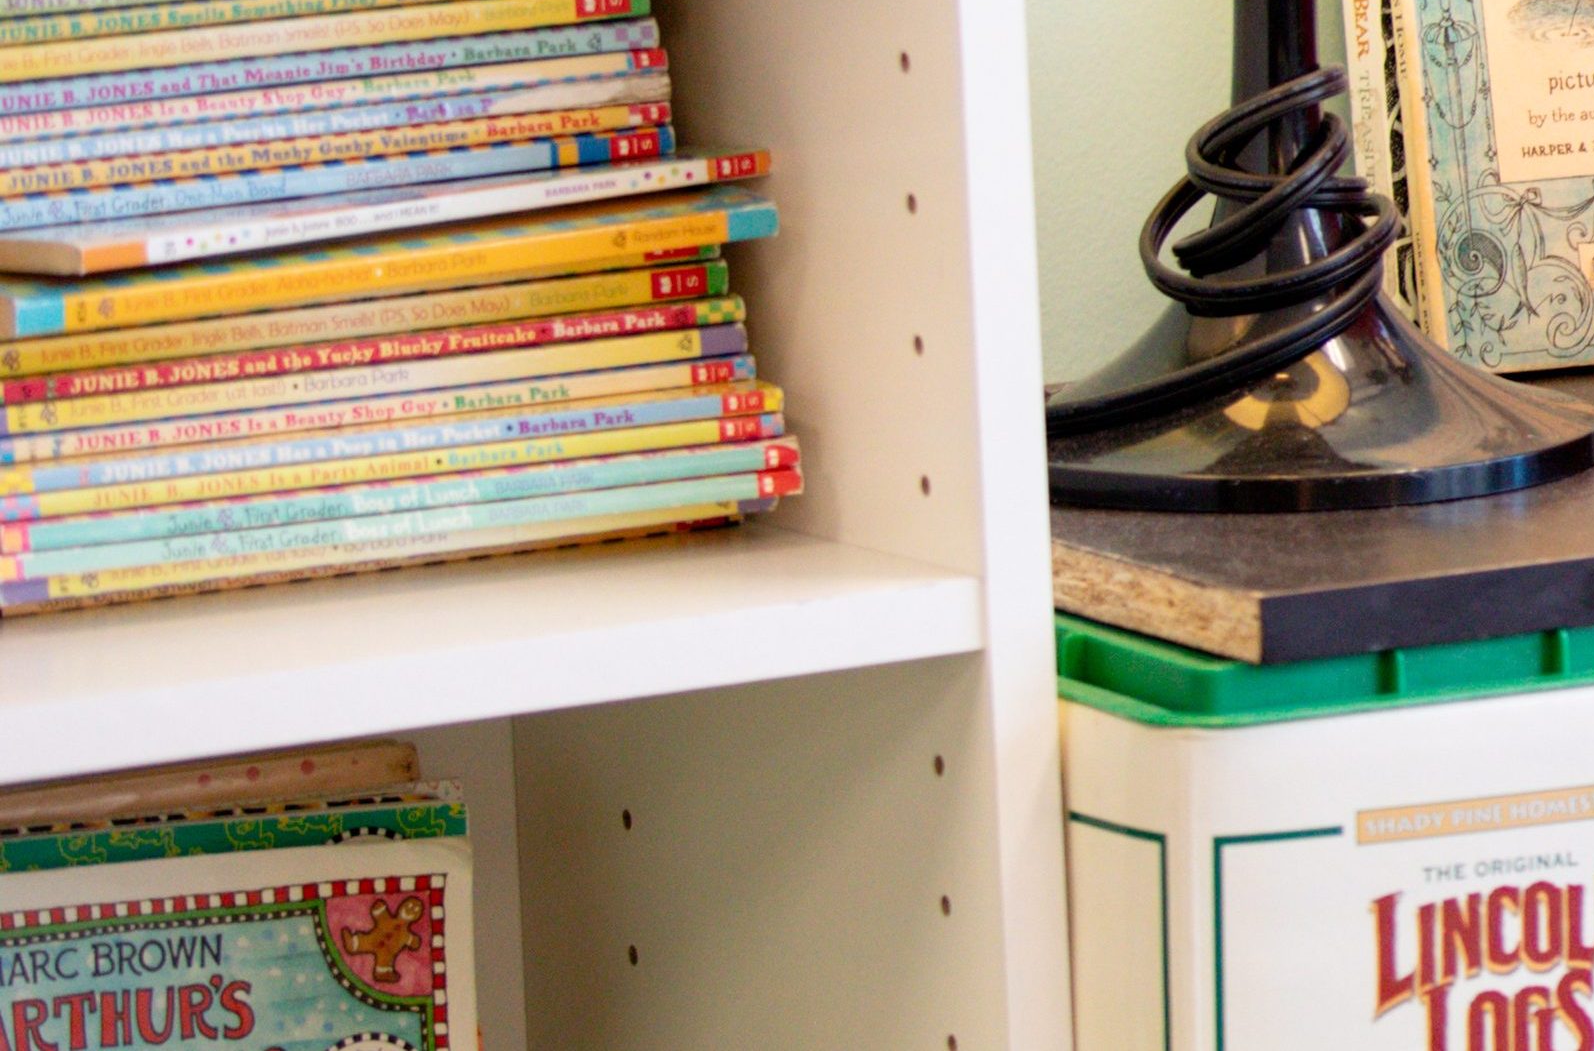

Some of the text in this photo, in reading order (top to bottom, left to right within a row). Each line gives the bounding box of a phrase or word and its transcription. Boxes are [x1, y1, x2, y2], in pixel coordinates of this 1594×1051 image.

[2, 95, 55, 111] UNIE
[87, 82, 154, 101] JONES
[160, 78, 191, 93] and
[197, 73, 238, 90] That
[244, 67, 310, 85] Meanie
[369, 51, 446, 72] Birthday
[463, 43, 530, 62] Barbara
[536, 39, 577, 55] Park
[1528, 110, 1547, 127] by
[1551, 106, 1575, 122] the
[1521, 141, 1574, 158] HARPER
[69, 372, 139, 394] JUNIE
[168, 359, 240, 384] JONES
[245, 355, 278, 374] and
[283, 348, 311, 370] the
[318, 341, 372, 365] Yucky
[380, 339, 442, 358] Blucky
[449, 327, 535, 350] Fruitcake
[552, 318, 618, 338] Barbara
[624, 313, 665, 329] Park
[1364, 809, 1445, 836] SHADY
[1450, 803, 1503, 826] PINE
[1423, 853, 1578, 881] THE ORIGINAL
[0, 934, 222, 986] ARC BROWN
[0, 974, 255, 1051] RTHUR'S
